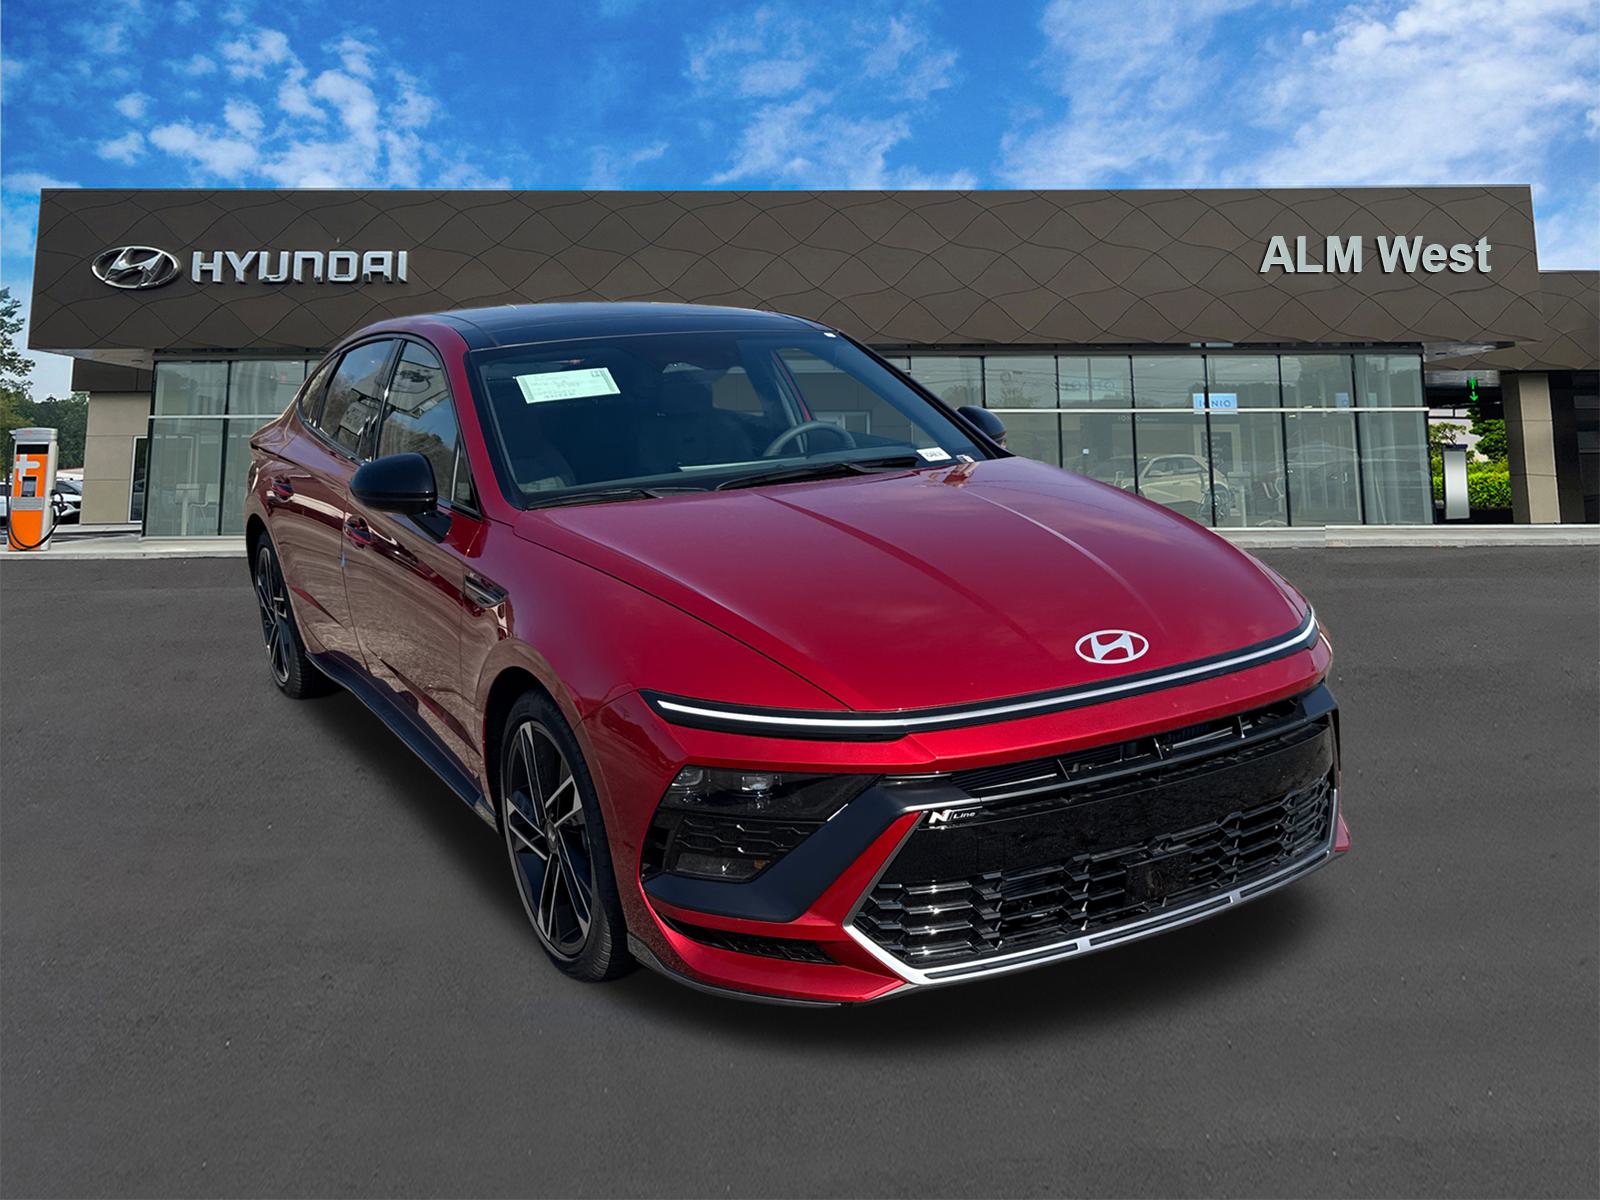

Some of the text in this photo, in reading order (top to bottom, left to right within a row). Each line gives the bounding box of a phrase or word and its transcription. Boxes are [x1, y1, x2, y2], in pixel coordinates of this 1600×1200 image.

[191, 250, 408, 283] HYUNDAI
[1260, 235, 1492, 273] ALM West
[928, 809, 952, 823] N
